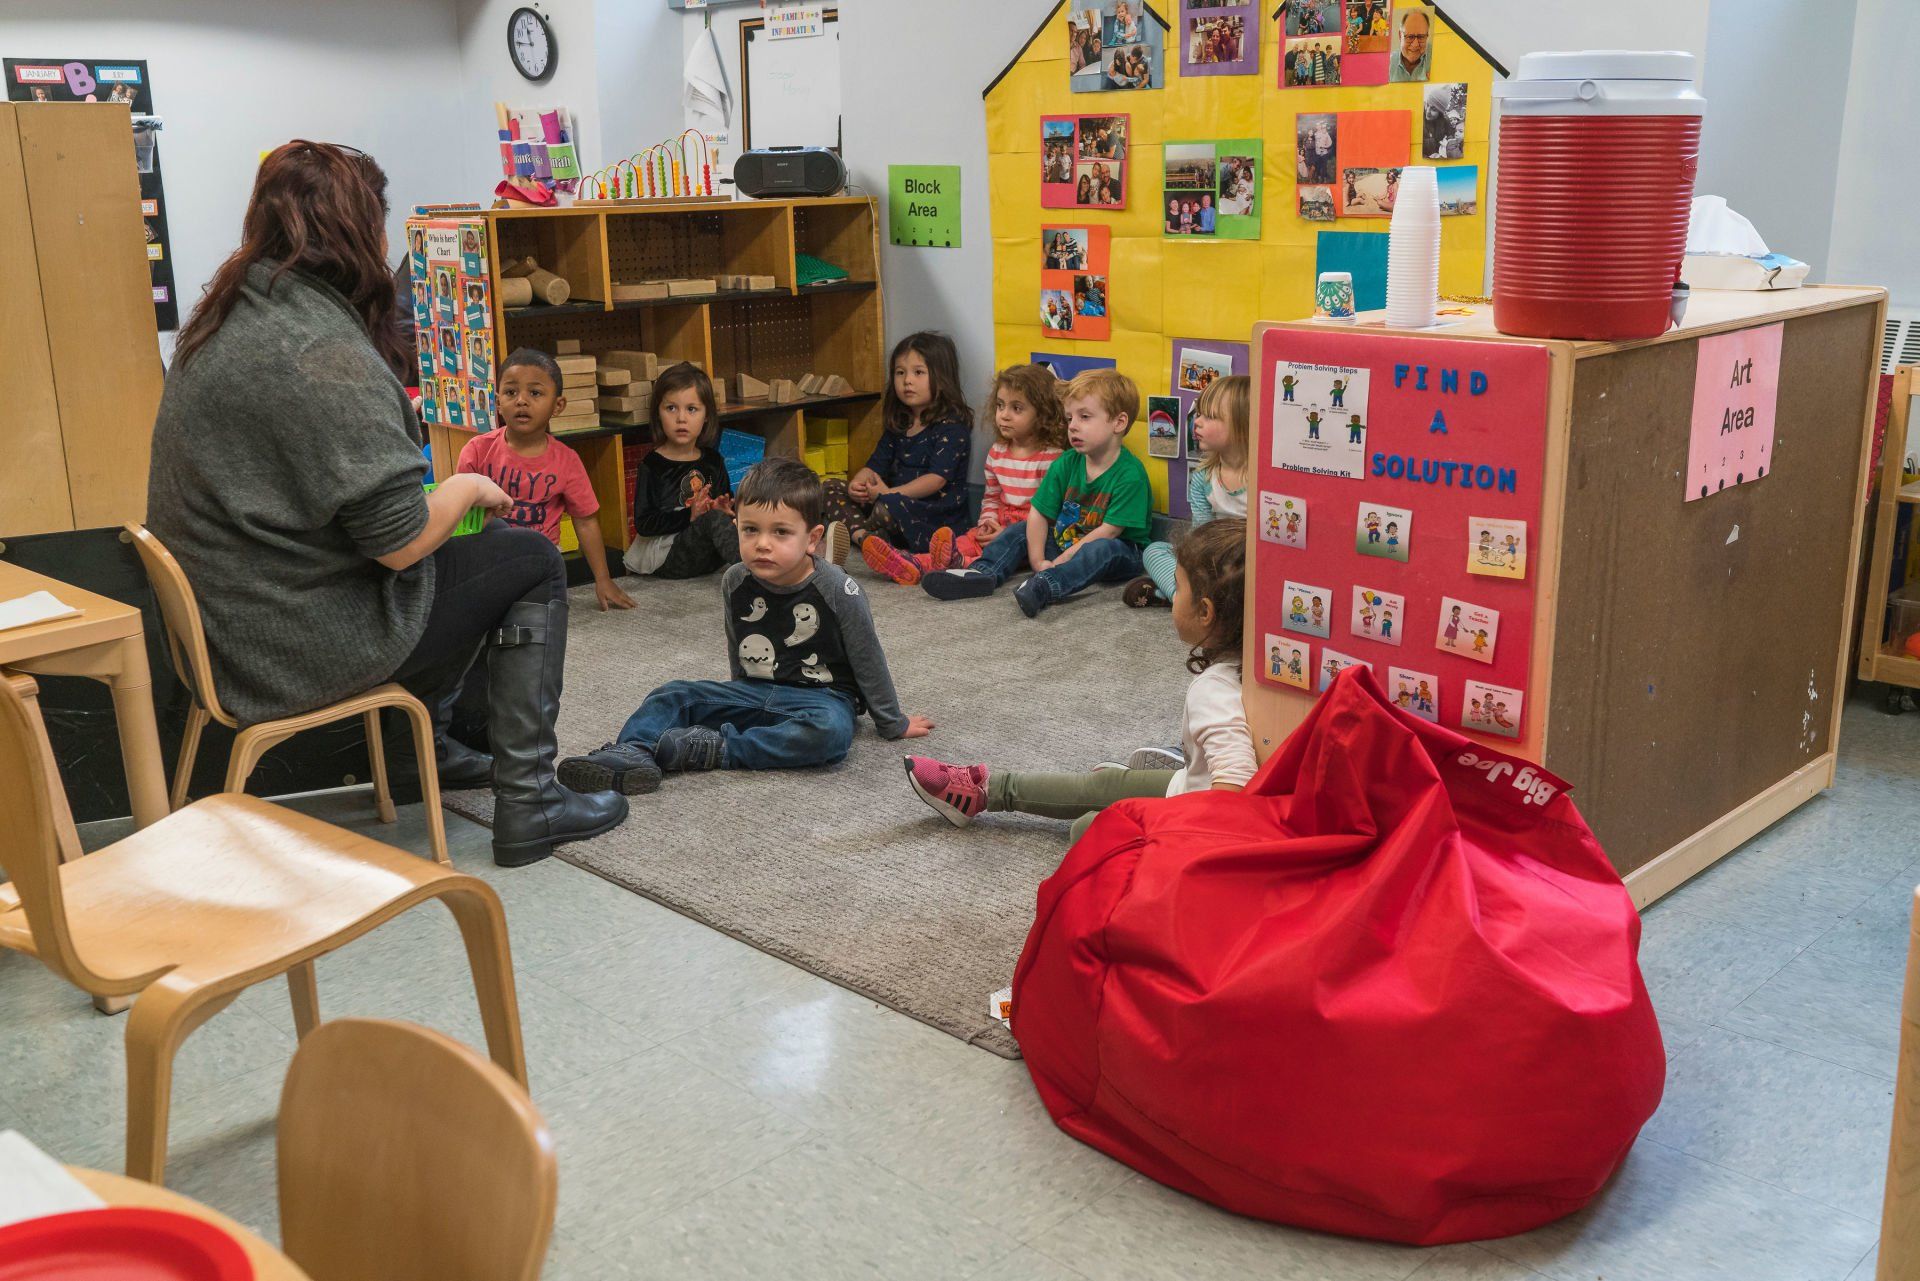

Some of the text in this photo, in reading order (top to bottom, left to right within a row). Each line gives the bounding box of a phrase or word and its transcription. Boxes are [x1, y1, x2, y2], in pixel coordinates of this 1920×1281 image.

[781, 11, 805, 22] FAMILY
[771, 24, 816, 37] INFORMATION
[25, 70, 57, 79] JANUARY
[63, 61, 97, 97] B
[904, 178, 941, 195] Block
[907, 201, 938, 218] Area
[445, 232, 458, 243] here?
[436, 247, 451, 256] Chart
[1287, 362, 1358, 375] Problem Solving Steps
[1730, 357, 1753, 389] Art
[1394, 363, 1489, 397] FIND
[1429, 409, 1449, 434] A
[1720, 406, 1755, 437] Area
[1282, 462, 1352, 478] Problem Solving Kit
[1371, 451, 1517, 494] SOLUTION
[1457, 752, 1558, 807] Big Joe
